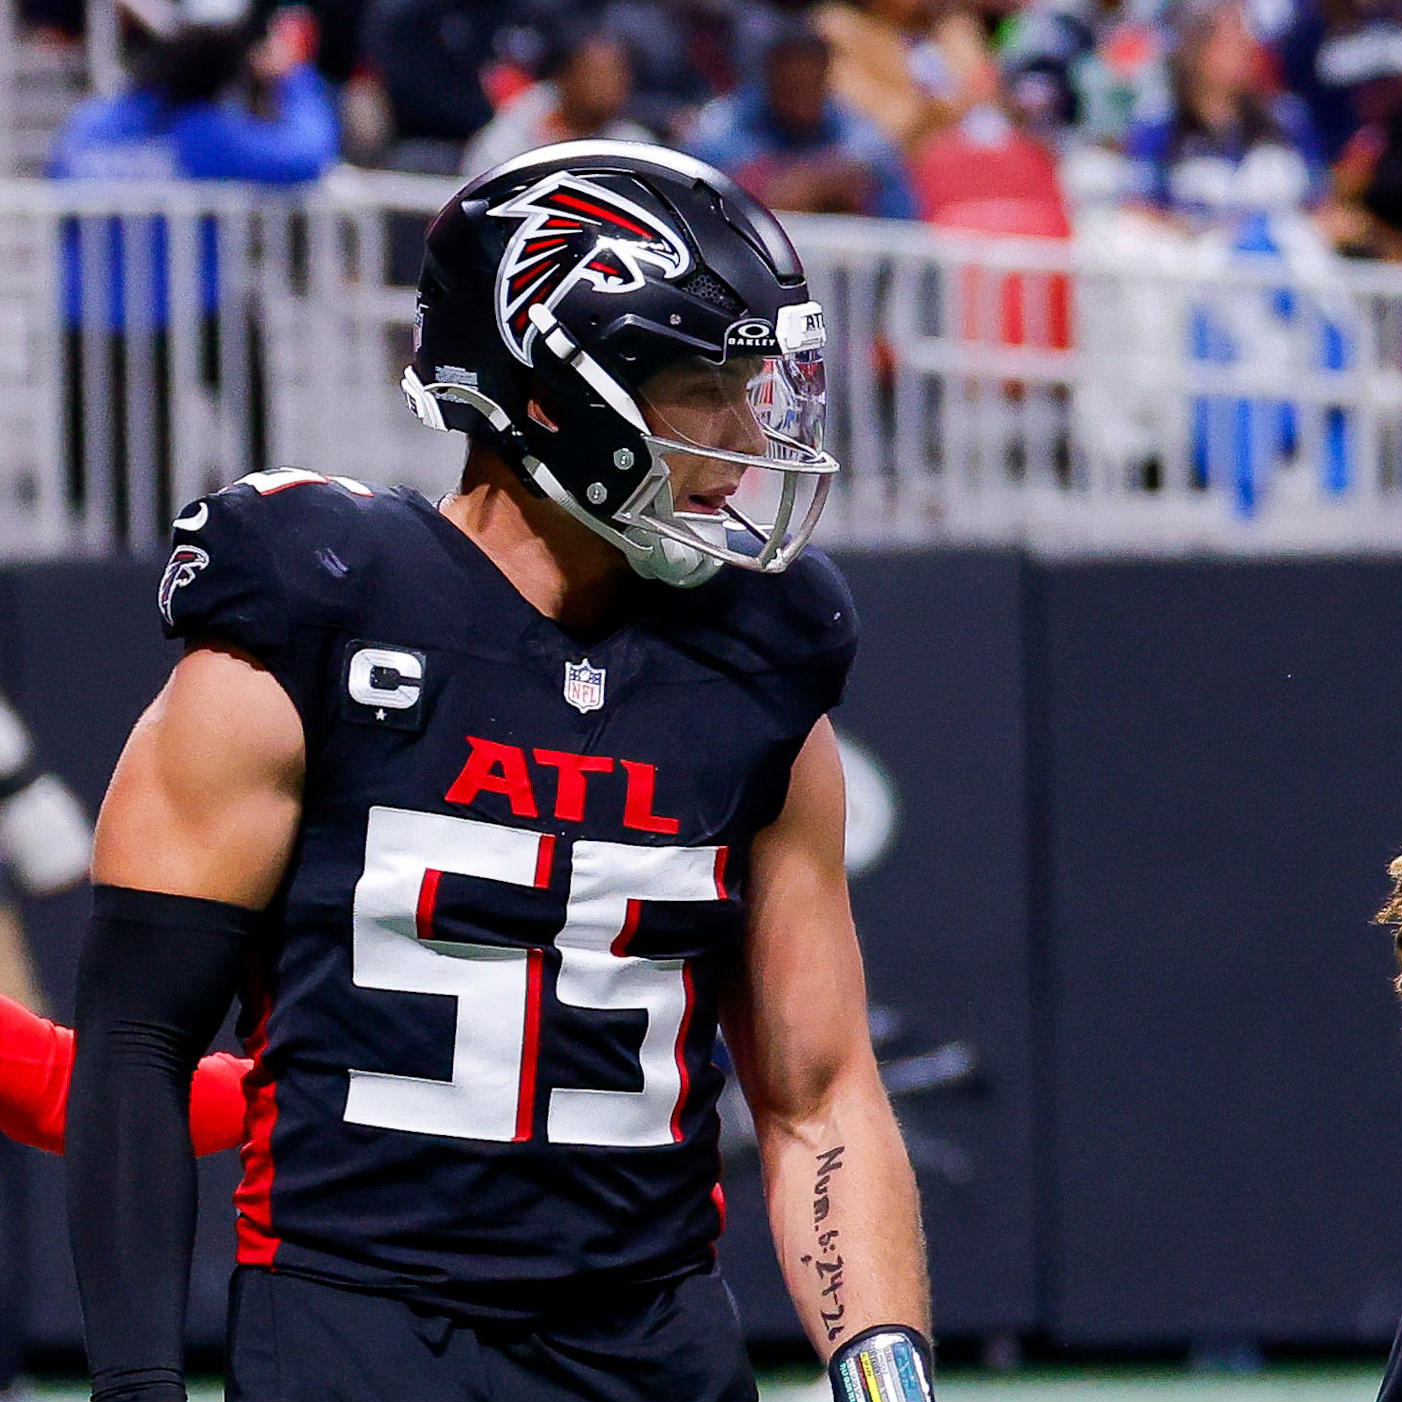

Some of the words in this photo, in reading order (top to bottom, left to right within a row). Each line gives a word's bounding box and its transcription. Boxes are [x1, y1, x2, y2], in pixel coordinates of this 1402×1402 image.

[728, 338, 776, 346] OAKLEY
[348, 647, 423, 710] C
[571, 682, 598, 704] NFL
[444, 734, 680, 835] ATL
[343, 805, 729, 1146] 55
